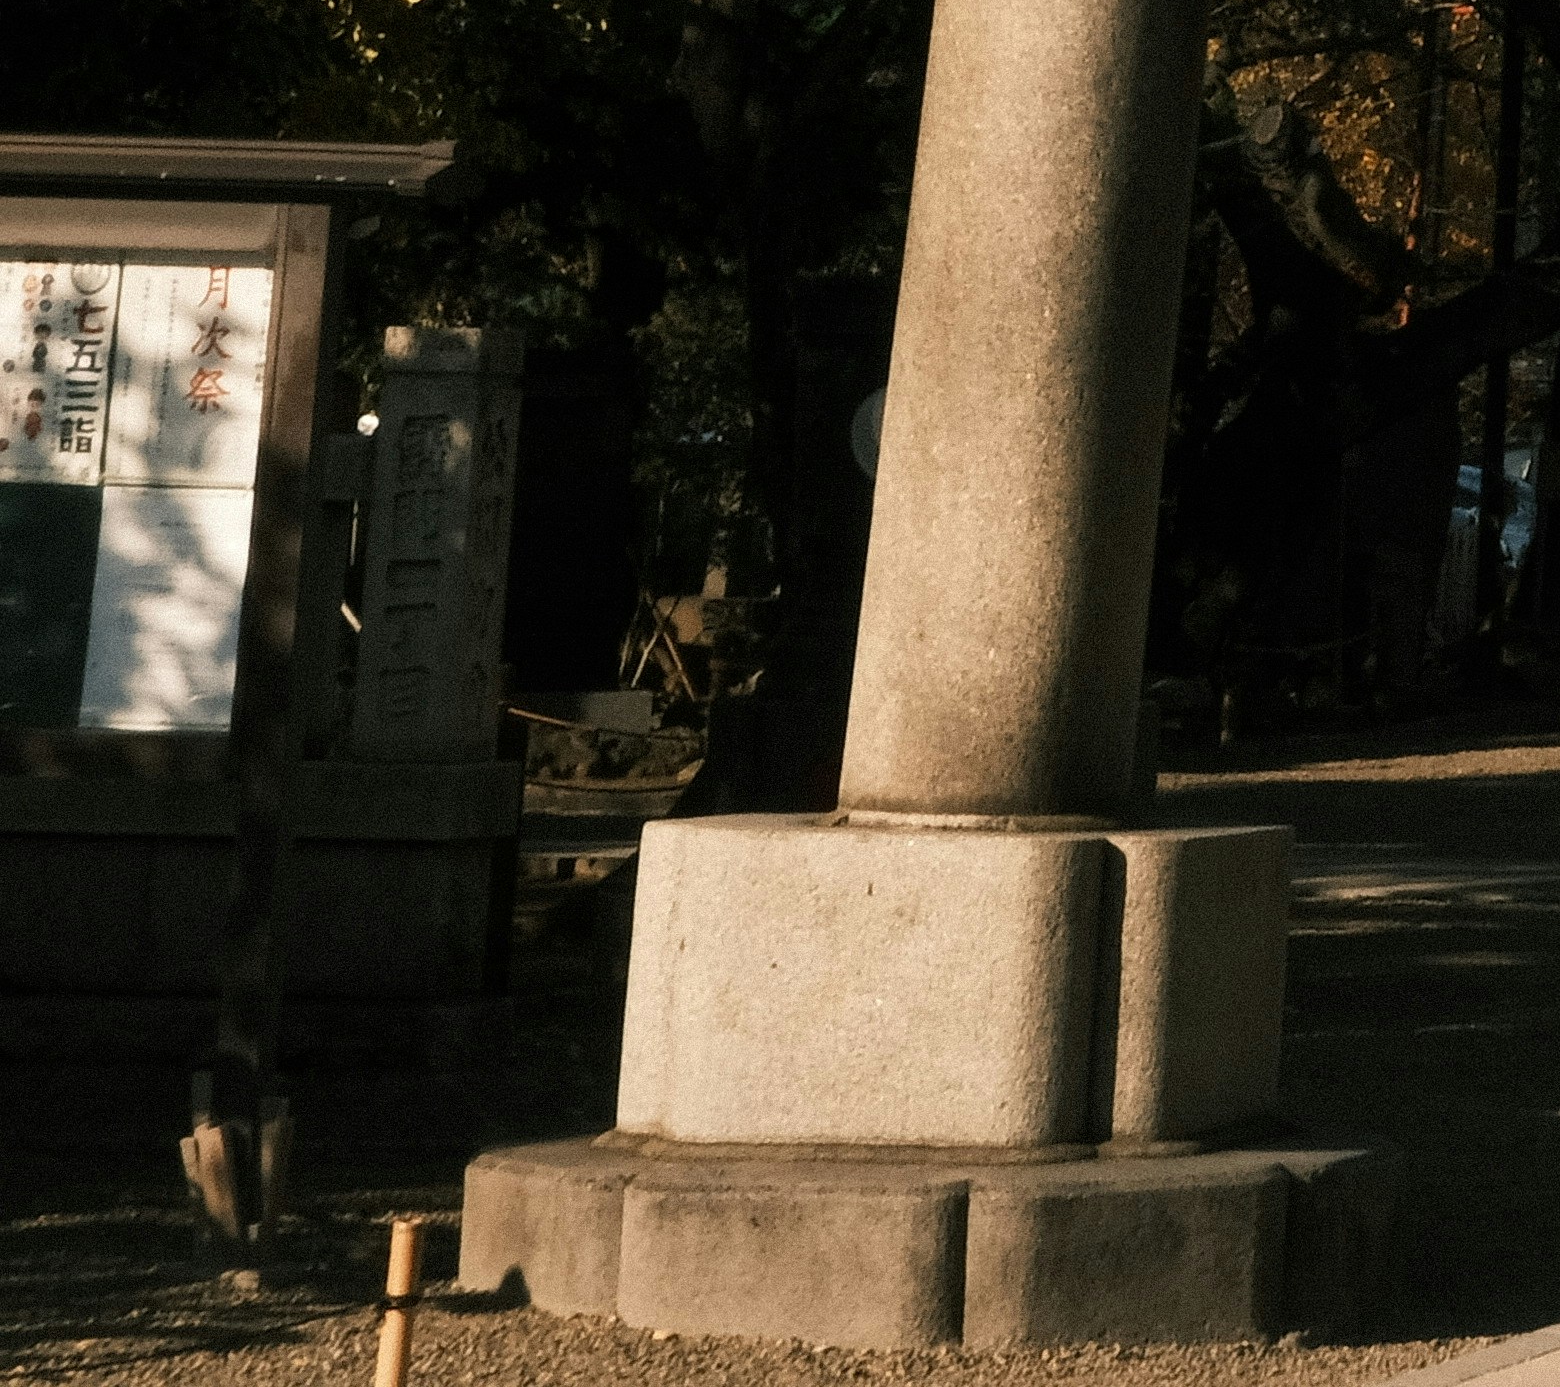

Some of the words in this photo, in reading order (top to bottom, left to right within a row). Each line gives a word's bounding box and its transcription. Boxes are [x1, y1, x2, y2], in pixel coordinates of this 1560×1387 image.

[58, 300, 107, 454] 七五三詣
[184, 267, 233, 415] 月次祭
